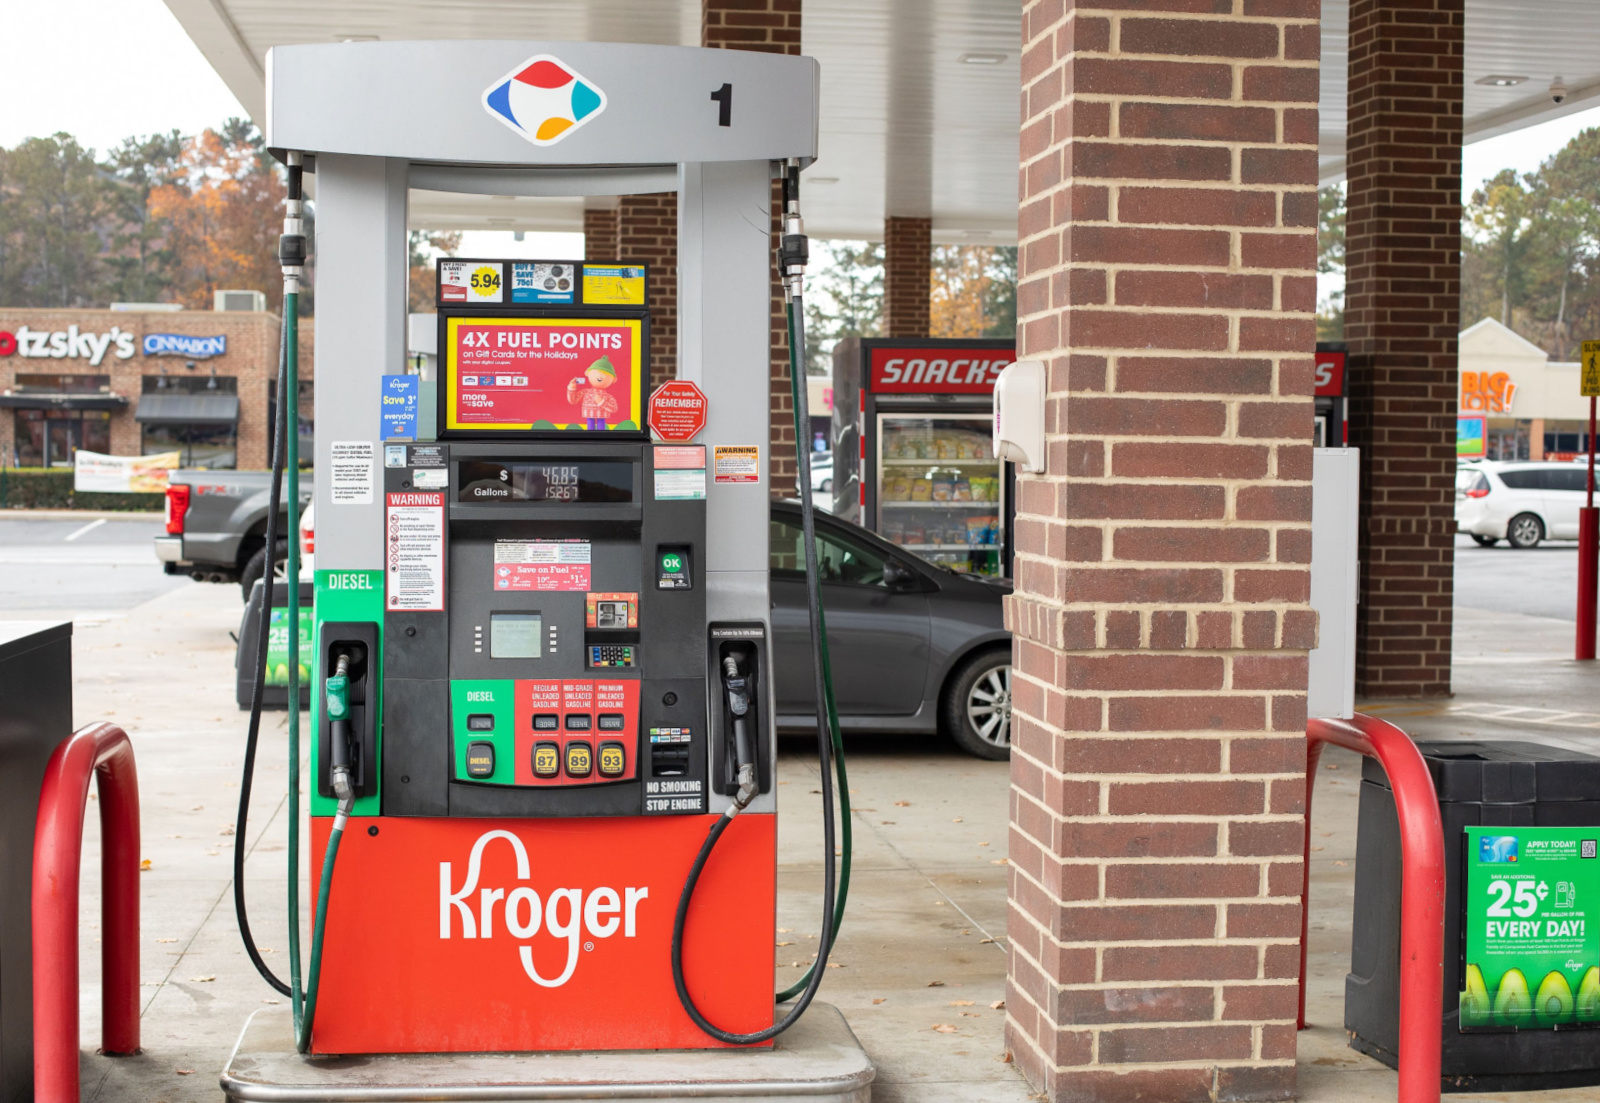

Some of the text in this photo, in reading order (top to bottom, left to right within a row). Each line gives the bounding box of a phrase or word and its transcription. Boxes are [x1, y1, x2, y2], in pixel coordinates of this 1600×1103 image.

[711, 83, 732, 127] 1
[470, 274, 501, 288] 5.94
[145, 334, 225, 355] CINNABON
[462, 332, 622, 349] 4X FUEL POINTS
[476, 350, 490, 358] Gift
[492, 350, 516, 358] Cards
[516, 351, 528, 359] for
[529, 351, 542, 359] the
[544, 351, 578, 360] Holidays
[390, 378, 410, 392] Kroger
[1462, 372, 1510, 394] BIG
[383, 396, 405, 405] Save
[655, 398, 702, 408] REMEMBER
[384, 413, 414, 421] everyday
[500, 470, 508, 481] $
[474, 488, 508, 496] Gallons
[390, 494, 440, 505] WARNING
[663, 559, 680, 568] OK
[329, 574, 373, 590] DIESEL
[269, 644, 289, 652] EVER
[467, 692, 494, 702] DIESEL
[470, 757, 490, 765] DIESEL
[538, 756, 554, 766] 87
[571, 756, 587, 766] 89
[604, 756, 620, 766] 93
[647, 781, 701, 793] NO SMOKING
[646, 799, 701, 811] STOP ENGINE
[1486, 880, 1549, 918] 25¢
[440, 829, 648, 988] Kroger
[1486, 920, 1585, 937] EVERY DAY!
[1565, 959, 1583, 972] Kroger
